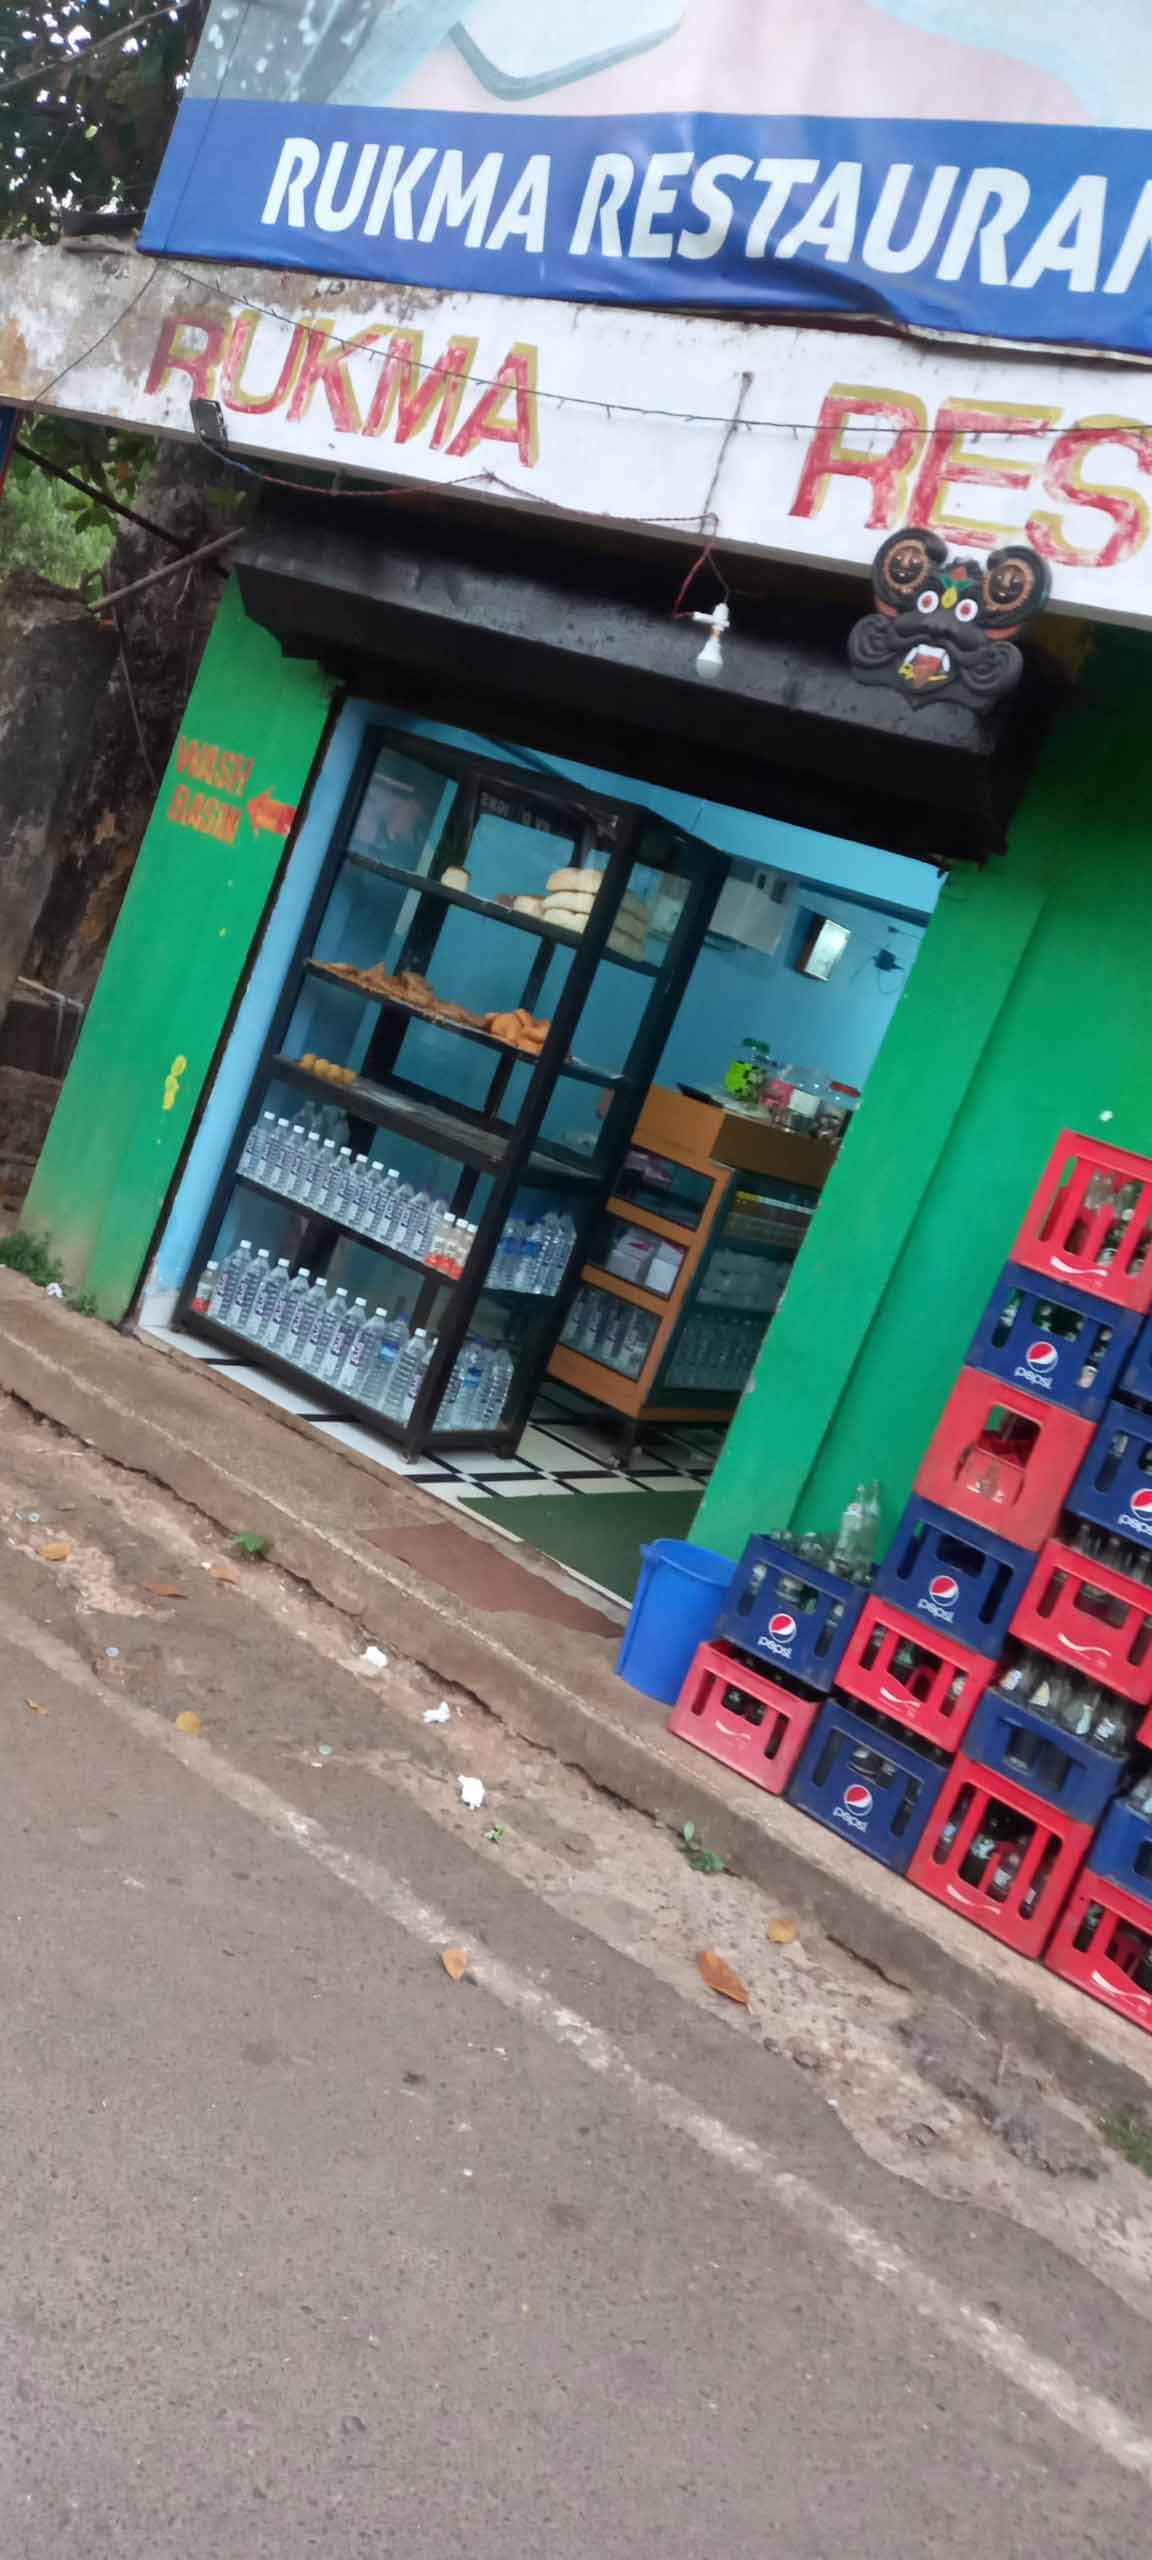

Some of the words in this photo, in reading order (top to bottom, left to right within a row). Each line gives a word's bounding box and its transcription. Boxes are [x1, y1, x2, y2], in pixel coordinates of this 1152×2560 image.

[261, 137, 550, 254] RUKMA
[144, 309, 541, 468] RUKMA
[788, 382, 1152, 568] RES
[176, 735, 255, 797] WASH
[1014, 1365, 1052, 1389] pepsi
[917, 1599, 955, 1624] pepsi
[758, 1635, 792, 1660] pepsi
[833, 1807, 869, 1833] pepsi
